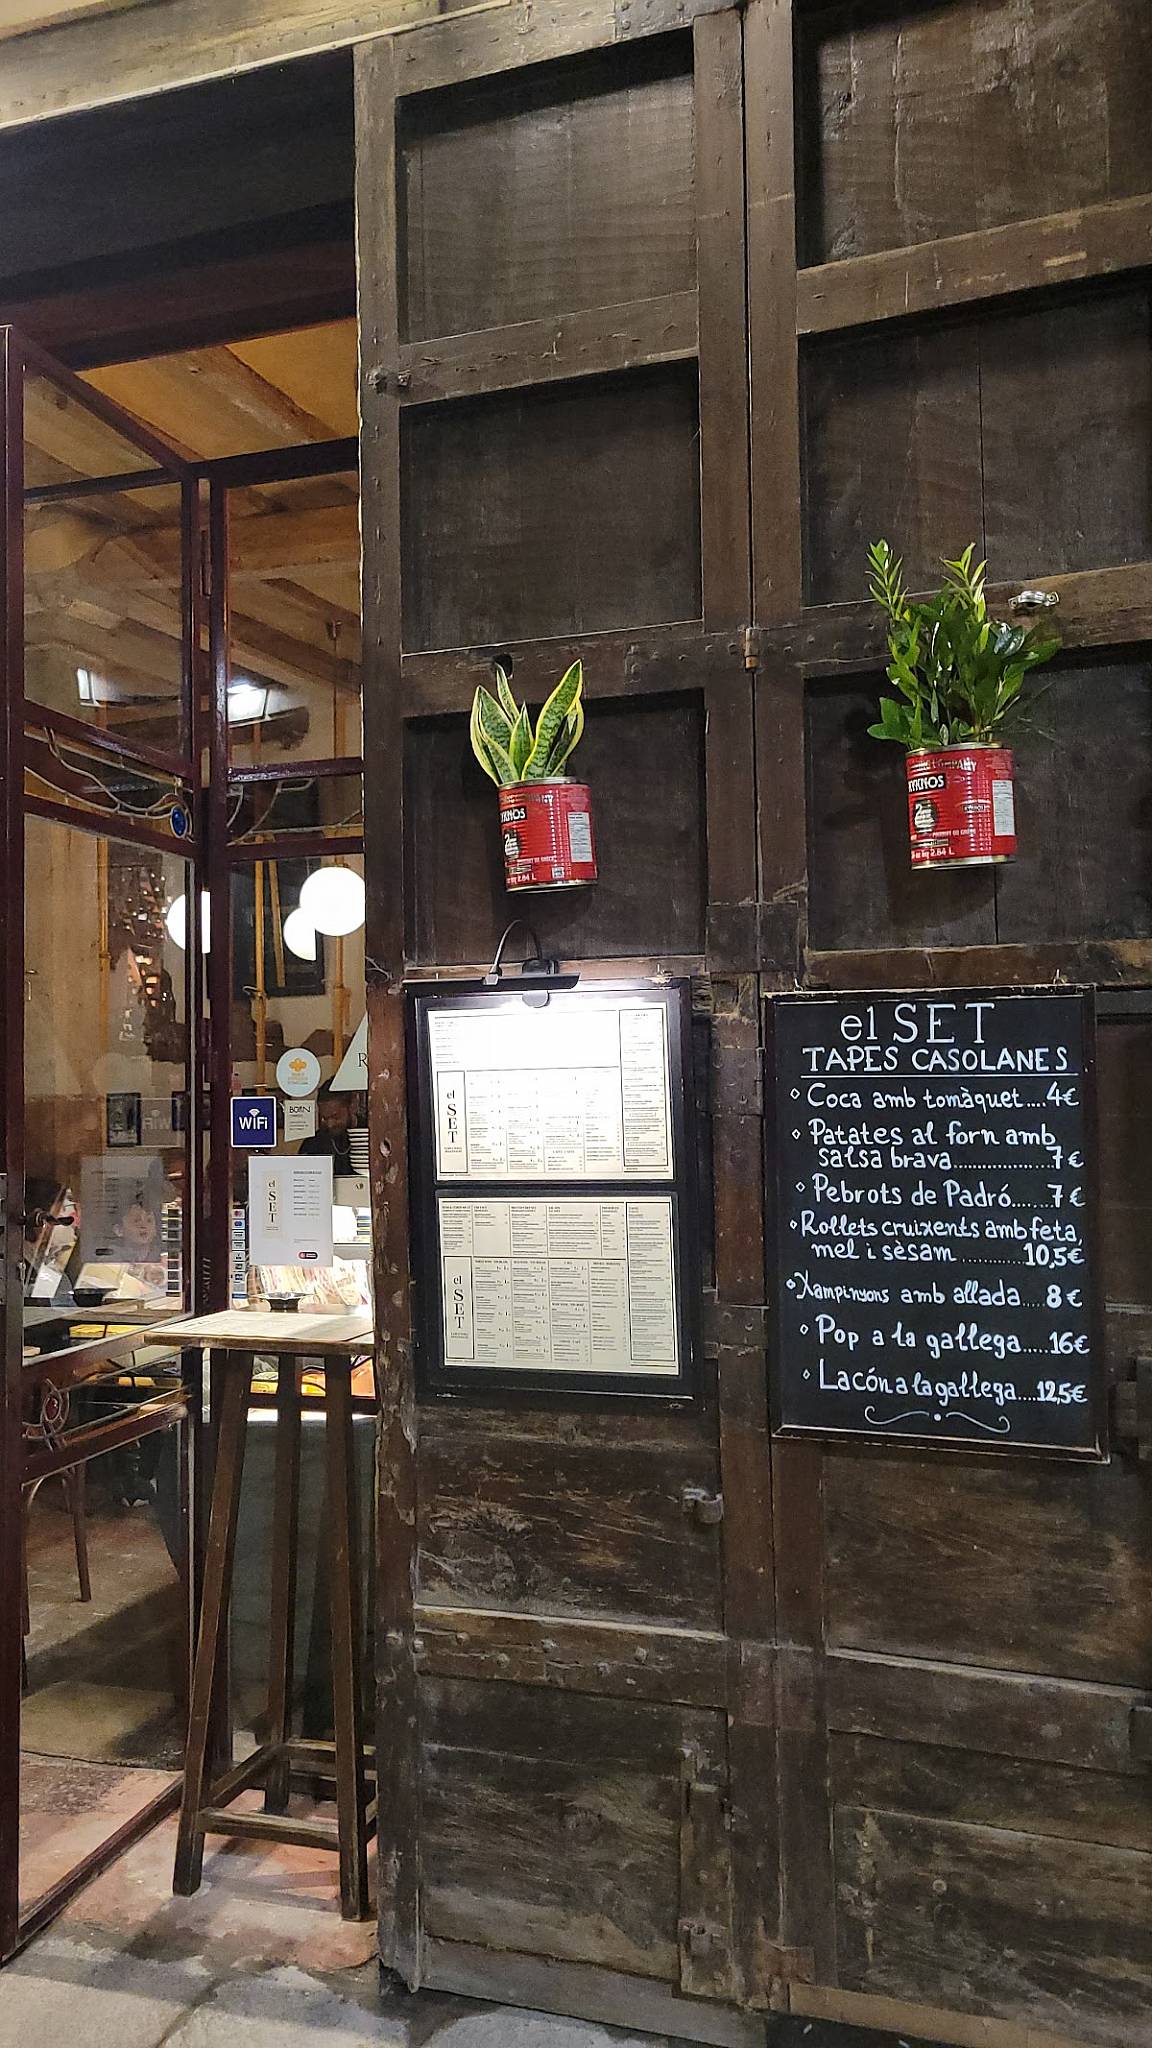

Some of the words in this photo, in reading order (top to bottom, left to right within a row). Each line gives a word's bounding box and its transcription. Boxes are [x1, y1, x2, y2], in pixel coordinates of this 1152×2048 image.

[840, 1006, 879, 1041] el
[893, 1002, 995, 1044] SET
[802, 1046, 899, 1072] TAPES
[911, 1047, 1068, 1072] CASOLANES
[807, 1082, 862, 1109] Coca
[872, 1086, 916, 1109] amb
[239, 1116, 268, 1130] WiFi
[808, 1118, 903, 1146] Patates
[911, 1121, 937, 1146] al
[945, 1120, 998, 1146] forn
[1005, 1123, 1056, 1146] amb
[818, 1146, 883, 1170] salsa
[811, 1172, 901, 1206] Pebrots
[911, 1181, 938, 1205] de
[801, 1210, 879, 1238] Rollets
[881, 1217, 980, 1239] cruixents
[985, 1220, 1027, 1240] amb
[811, 1240, 860, 1260] mel
[866, 1242, 876, 1261] i
[883, 1240, 957, 1262] sèsam
[794, 1270, 890, 1305] Xampinyons
[900, 1282, 945, 1305] amb
[815, 1314, 859, 1351] Pop
[872, 1328, 885, 1347] a
[891, 1321, 916, 1348] la
[819, 1358, 892, 1395] Lacón
[896, 1376, 908, 1395] a
[910, 1371, 932, 1397] la
